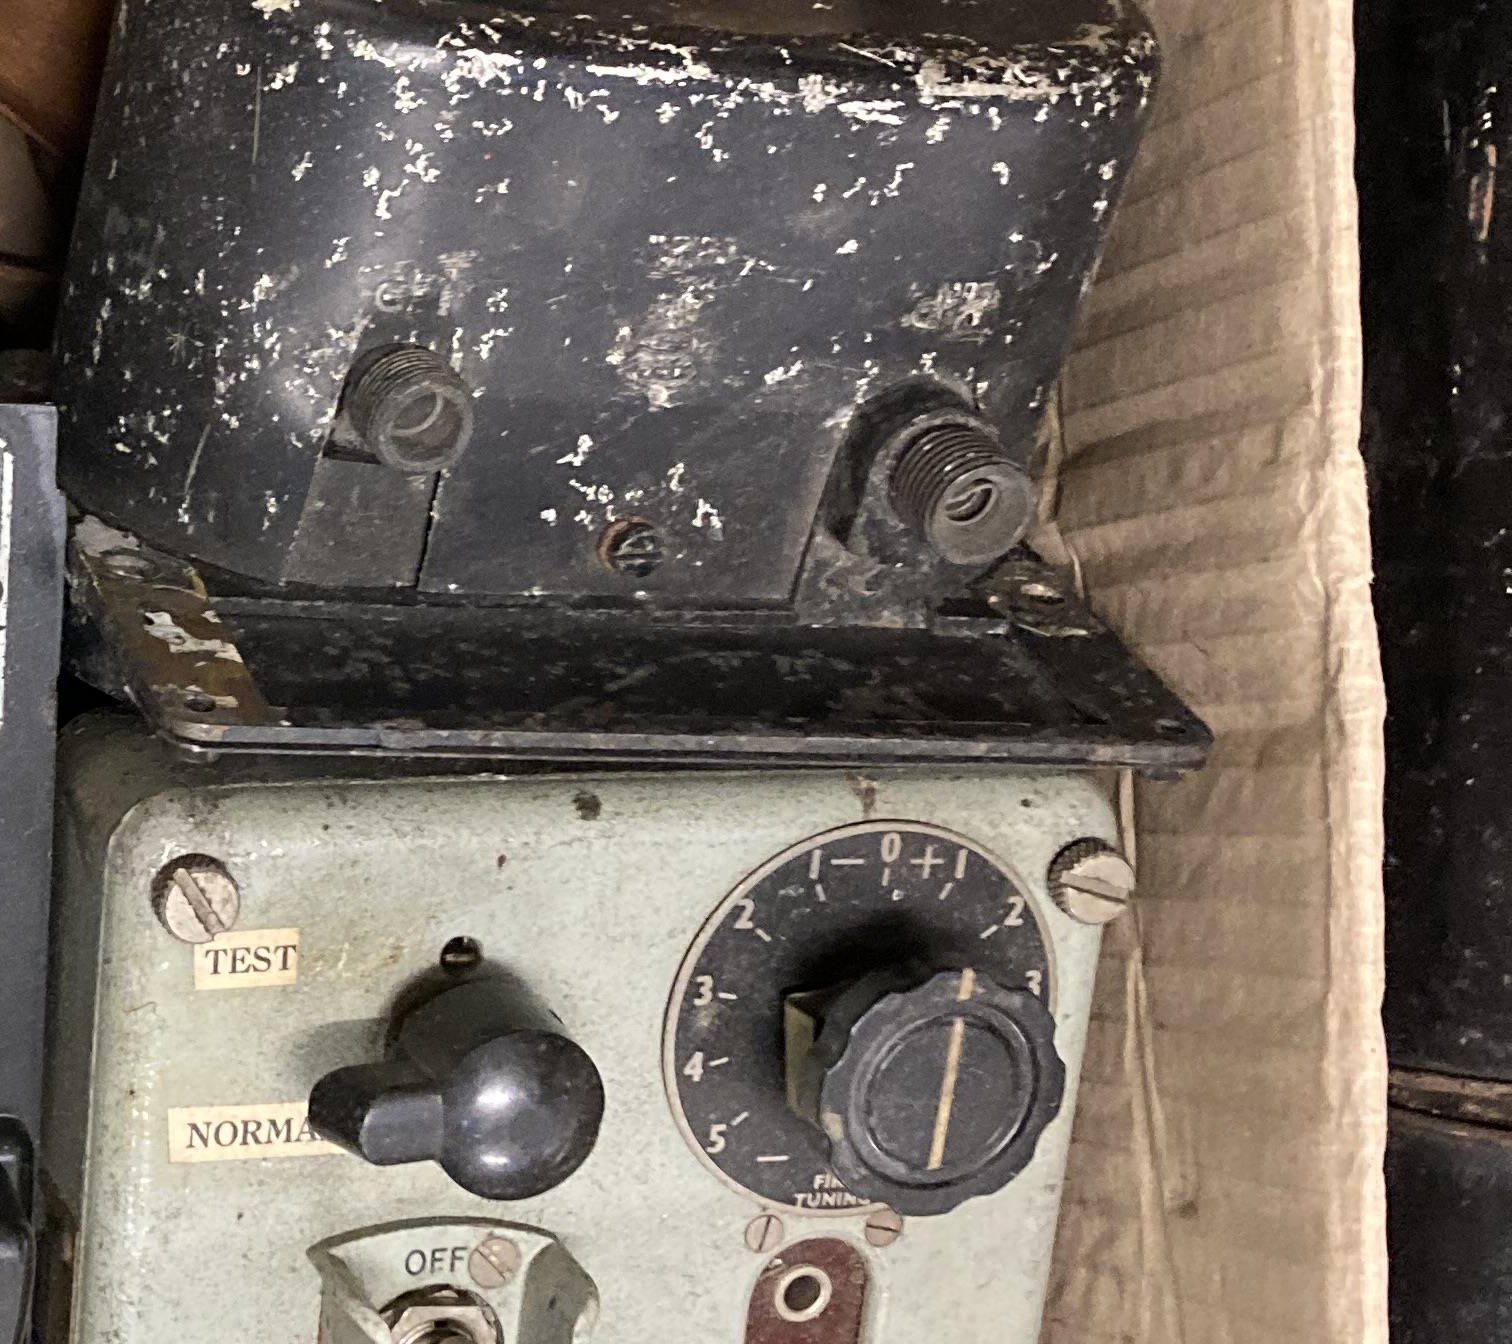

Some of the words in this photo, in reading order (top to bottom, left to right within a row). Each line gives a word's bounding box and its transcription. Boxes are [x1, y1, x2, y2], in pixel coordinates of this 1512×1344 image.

[881, 832, 902, 862] 0
[732, 897, 757, 930] 2
[1002, 896, 1027, 927] 2
[205, 944, 297, 975] TEST
[694, 974, 714, 1007] 3
[683, 1050, 705, 1083] 4
[186, 1116, 324, 1149] NORMA
[706, 1123, 728, 1154] 5
[404, 1246, 469, 1276] OFF
